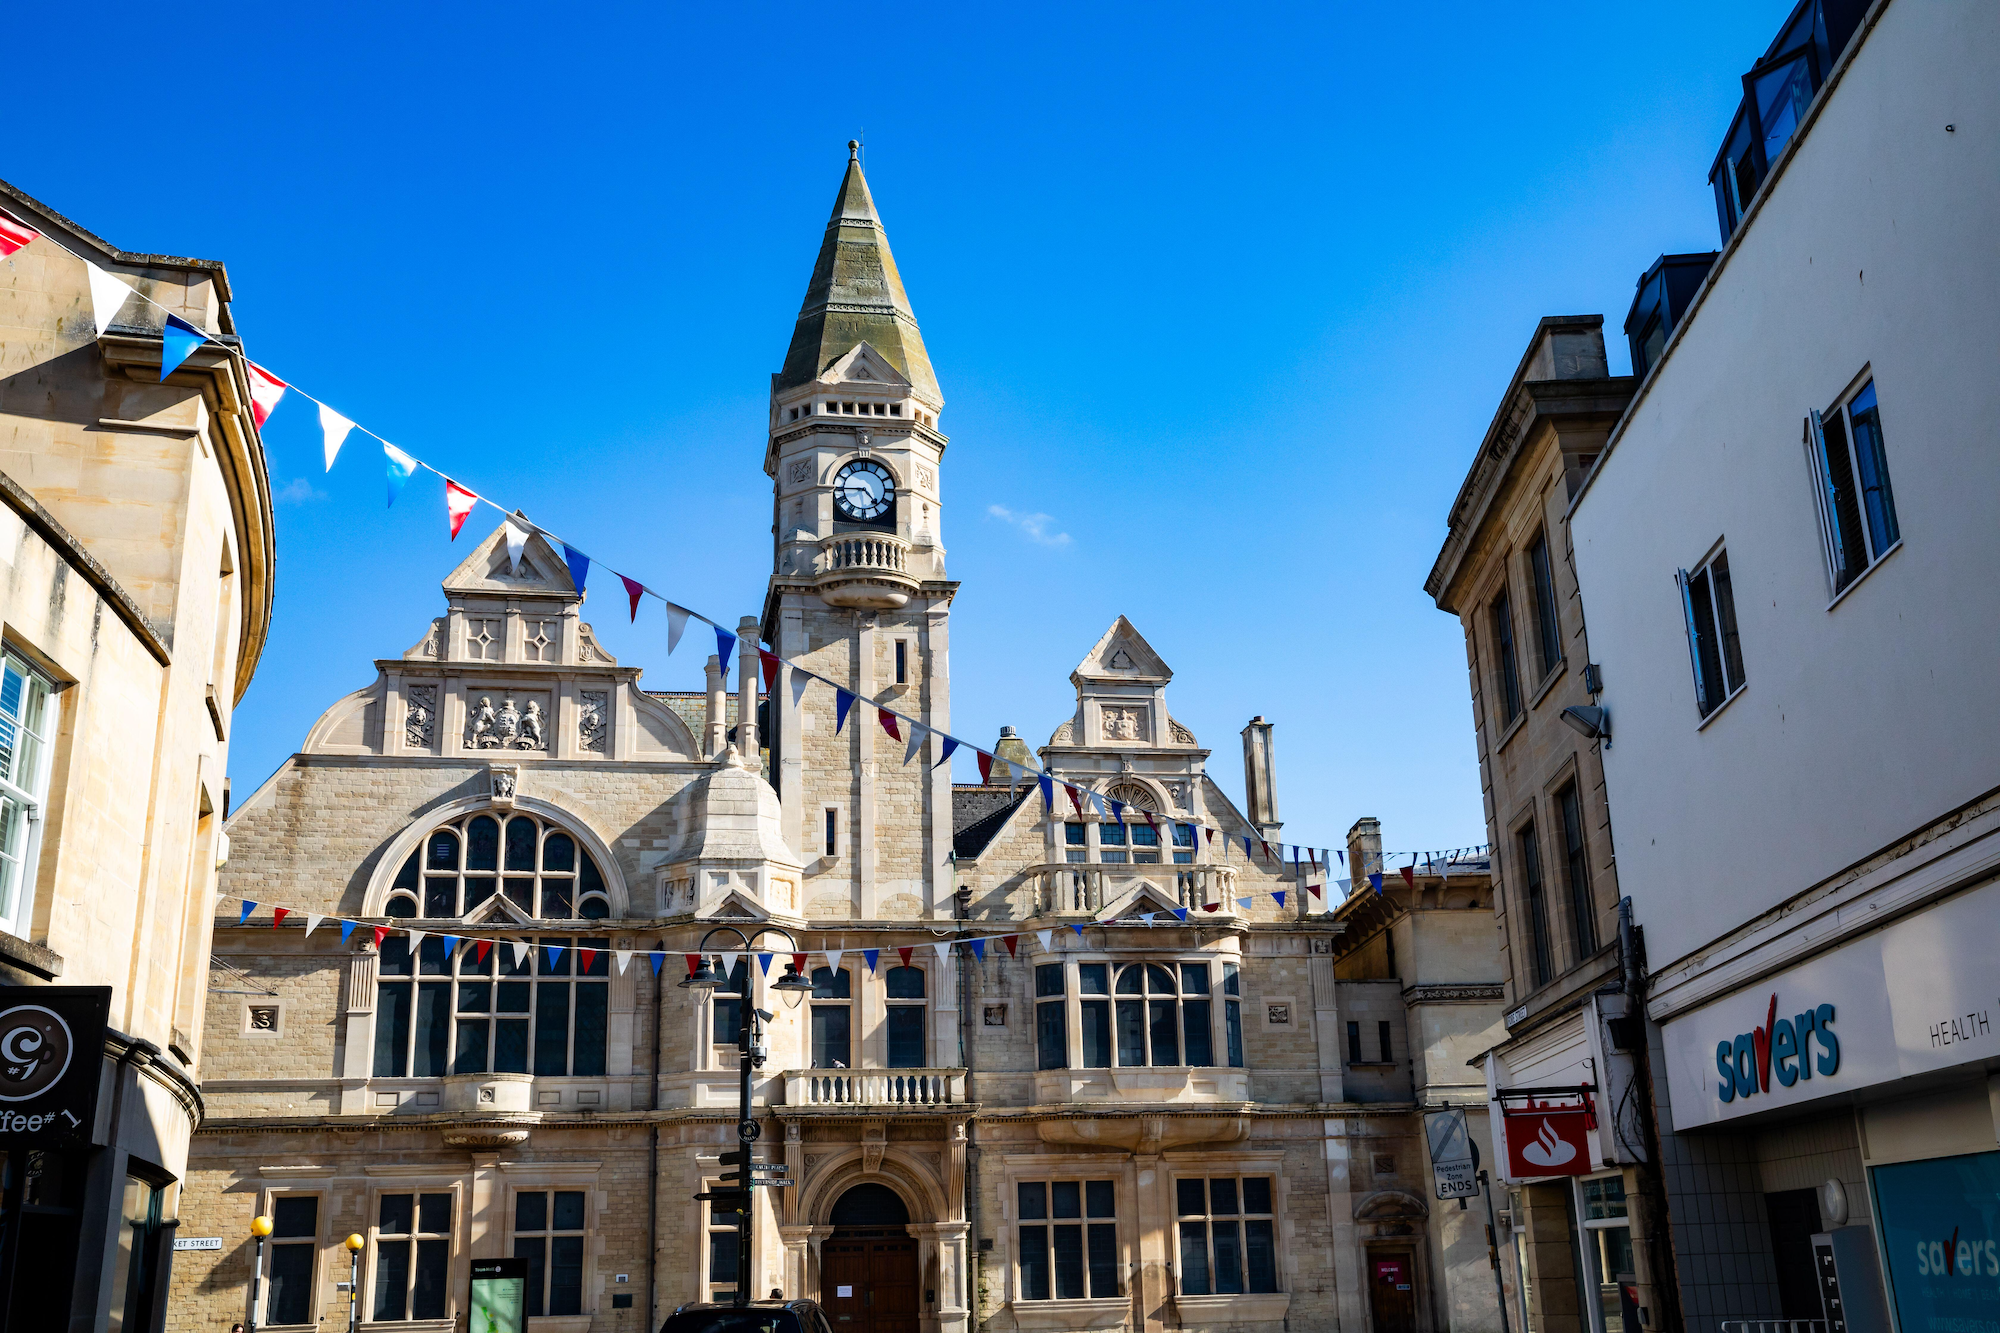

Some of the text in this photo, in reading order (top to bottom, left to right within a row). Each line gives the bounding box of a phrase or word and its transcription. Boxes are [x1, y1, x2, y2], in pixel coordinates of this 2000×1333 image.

[1929, 1010, 1991, 1048] HEALTH
[1716, 992, 1840, 1103] savers
[1436, 1163, 1471, 1173] Pedestrian
[1446, 1173, 1463, 1181] Zone
[1441, 1180, 1472, 1193] ENDS
[190, 1239, 219, 1247] STREET
[1916, 1225, 2000, 1277] savers
